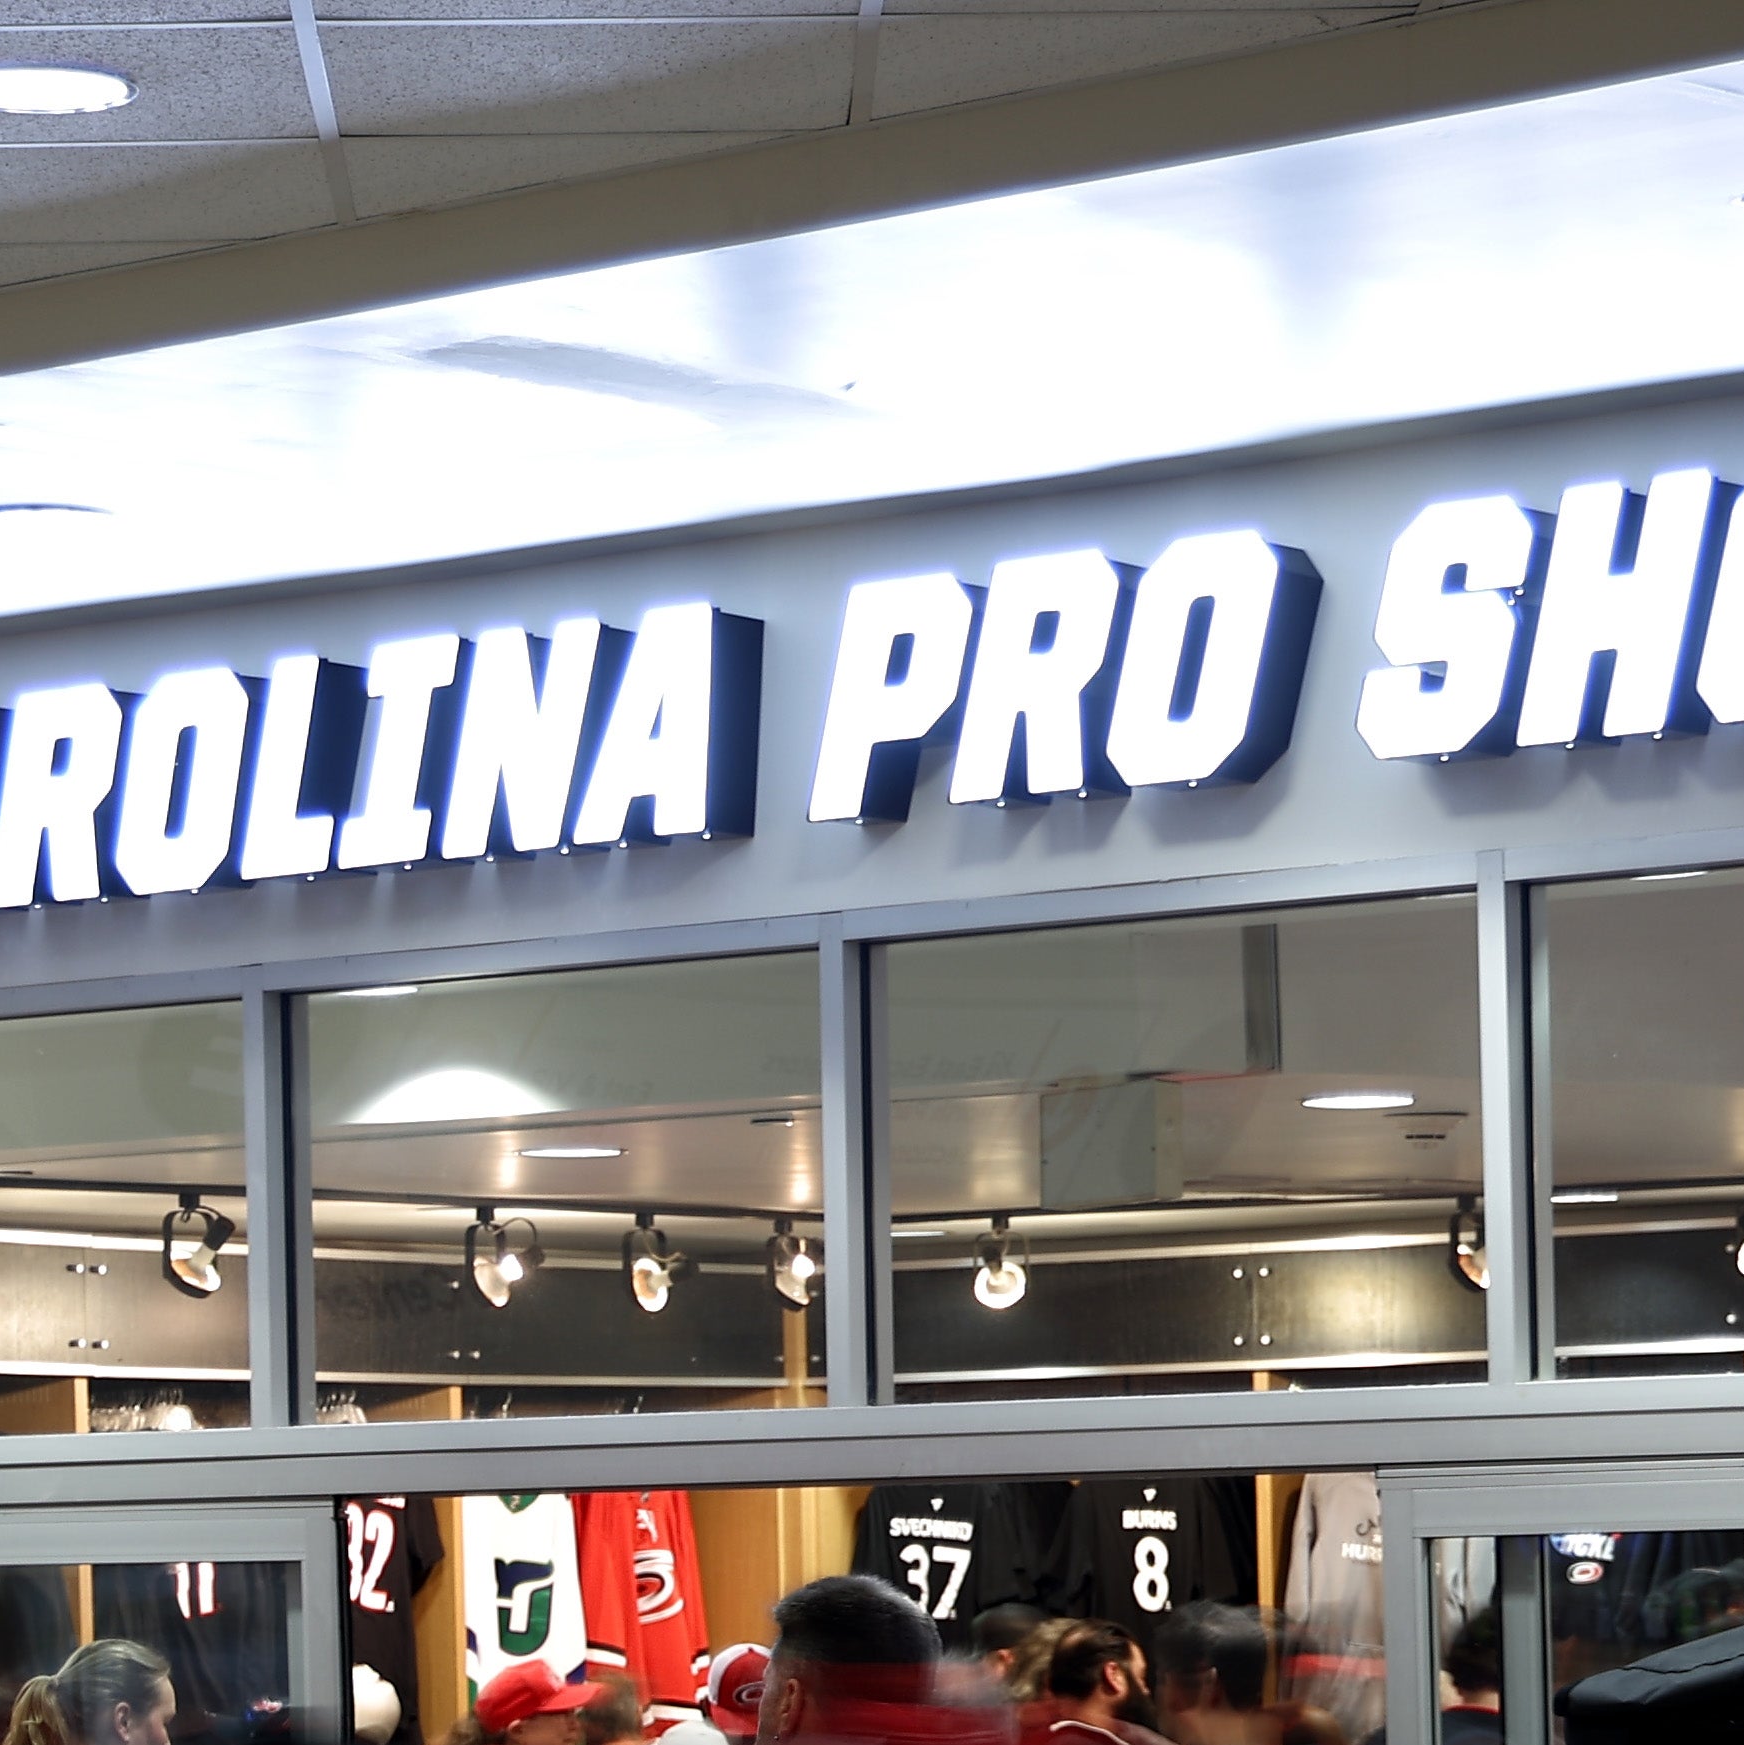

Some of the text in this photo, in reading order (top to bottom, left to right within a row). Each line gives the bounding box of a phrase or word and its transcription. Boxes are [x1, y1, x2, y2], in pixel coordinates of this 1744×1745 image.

[805, 528, 1285, 824] PRO
[1121, 1508, 1178, 1531] BURNS
[899, 1543, 972, 1620] 37
[1131, 1535, 1170, 1612] 8
